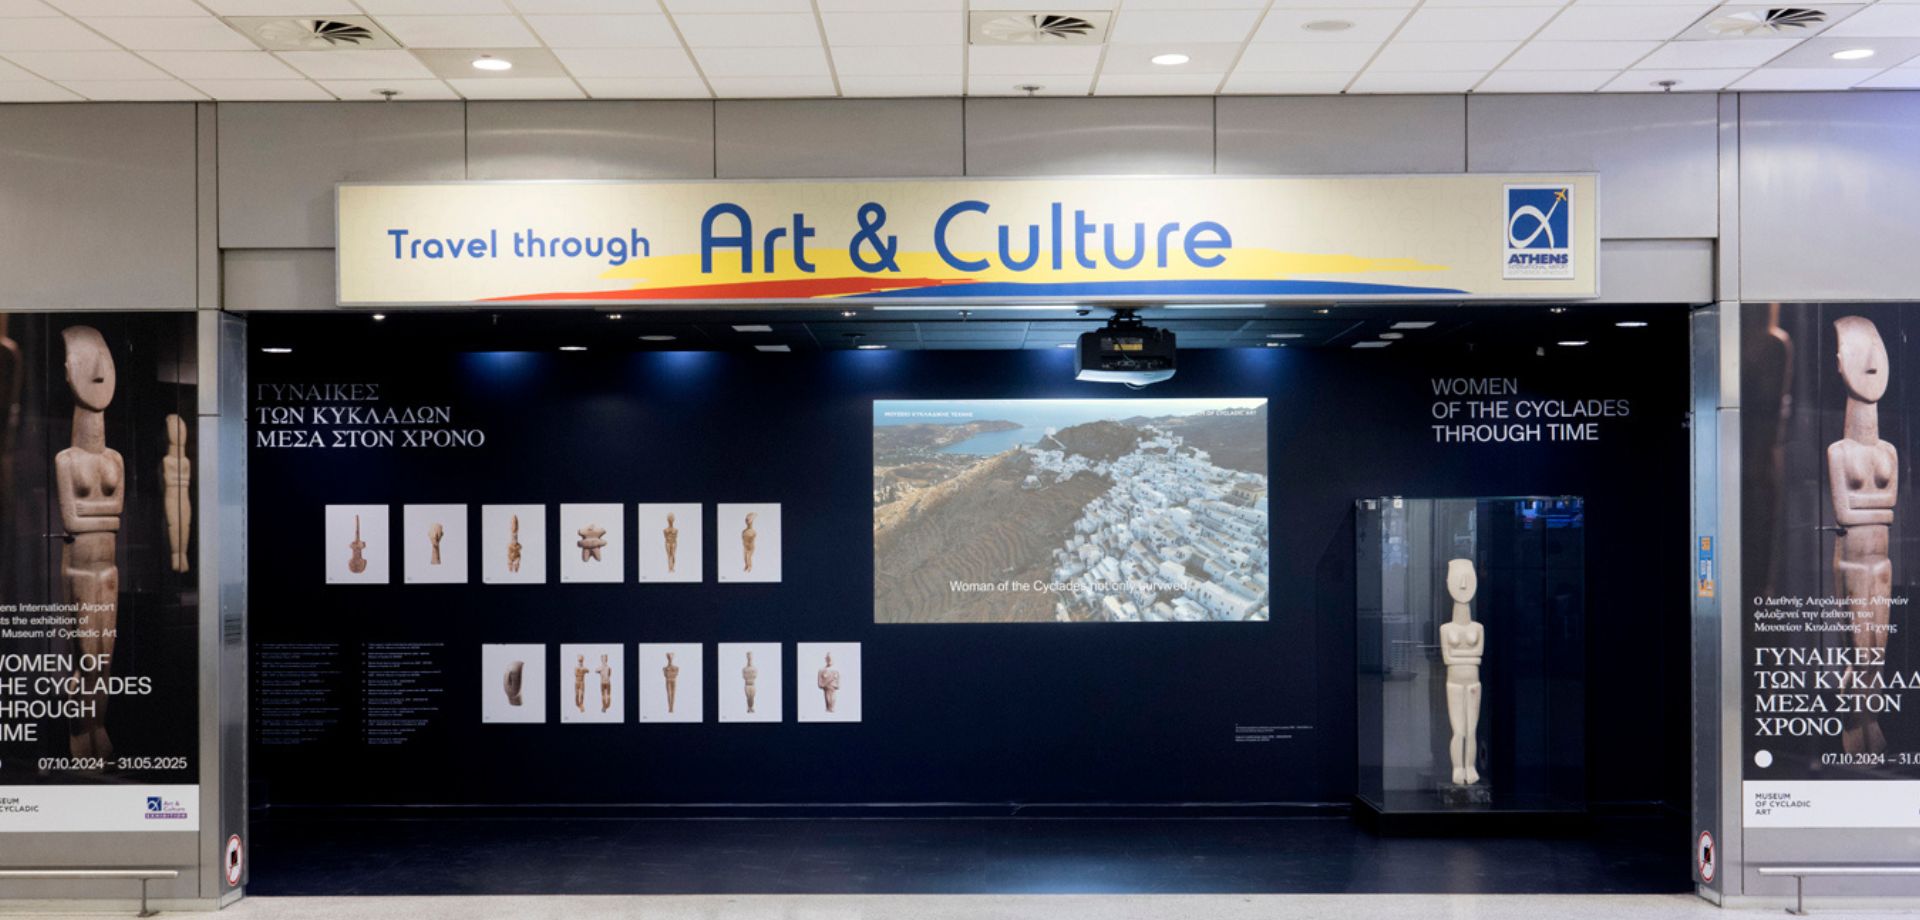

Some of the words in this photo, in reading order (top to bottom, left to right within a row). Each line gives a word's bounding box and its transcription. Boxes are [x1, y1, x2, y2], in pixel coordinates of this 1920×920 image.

[387, 228, 497, 259] Travel
[513, 228, 650, 266] through
[700, 201, 816, 273] Art
[848, 201, 901, 273] &
[933, 199, 1233, 273] Culture
[1508, 253, 1569, 265] ATHENS
[257, 383, 380, 401] ΓΥΝΑΙΚΕΣ
[1431, 377, 1518, 396] WOMEN
[256, 406, 305, 425] ΤΩΝ
[312, 406, 451, 425] ΚΥΚΛΑΔΩΝ
[1432, 401, 1461, 419] OF
[1466, 401, 1509, 419] THE
[1515, 399, 1630, 418] CYCLADES
[256, 430, 326, 448] ΜΕΣΑ
[331, 429, 395, 448] ΣΤΟΝ
[401, 428, 485, 448] ΧΡΟΝΟ
[1432, 424, 1541, 443] THROUGH
[1546, 423, 1599, 441] TIME
[950, 580, 994, 592] Woman
[998, 579, 1010, 592] of
[1011, 579, 1030, 592] the
[1033, 579, 1086, 595] Cyclades
[0, 604, 17, 612] ens
[19, 602, 79, 612] International
[81, 602, 115, 614] Airport
[12, 616, 28, 625] the
[30, 615, 77, 625] exhibition
[79, 615, 89, 625] of
[2, 628, 44, 638] Museum
[46, 628, 56, 638] of
[58, 627, 100, 639] Cycladic
[102, 627, 118, 638] Art
[79, 653, 111, 672] OF
[1754, 647, 1886, 666] ΓΥΝΑΙΚΕΣ
[0, 677, 28, 695] HE
[34, 676, 153, 695] CYCLADES
[1754, 670, 1807, 689] ΤΩΝ
[1814, 670, 1920, 689] ΚΥΚΛΑΔ
[0, 699, 96, 718] HROUGH
[1755, 694, 1829, 712] ΜΕΣΑ
[1835, 693, 1902, 712] ΣΤΟΝ
[0, 723, 38, 741] IME
[1755, 717, 1843, 736] ΧΡΟΝΟ
[38, 757, 104, 770] 07.10.2024
[118, 757, 188, 770] 31.05.2025
[1821, 752, 1885, 765] 07.10.2024
[1899, 752, 1920, 765] 31.0
